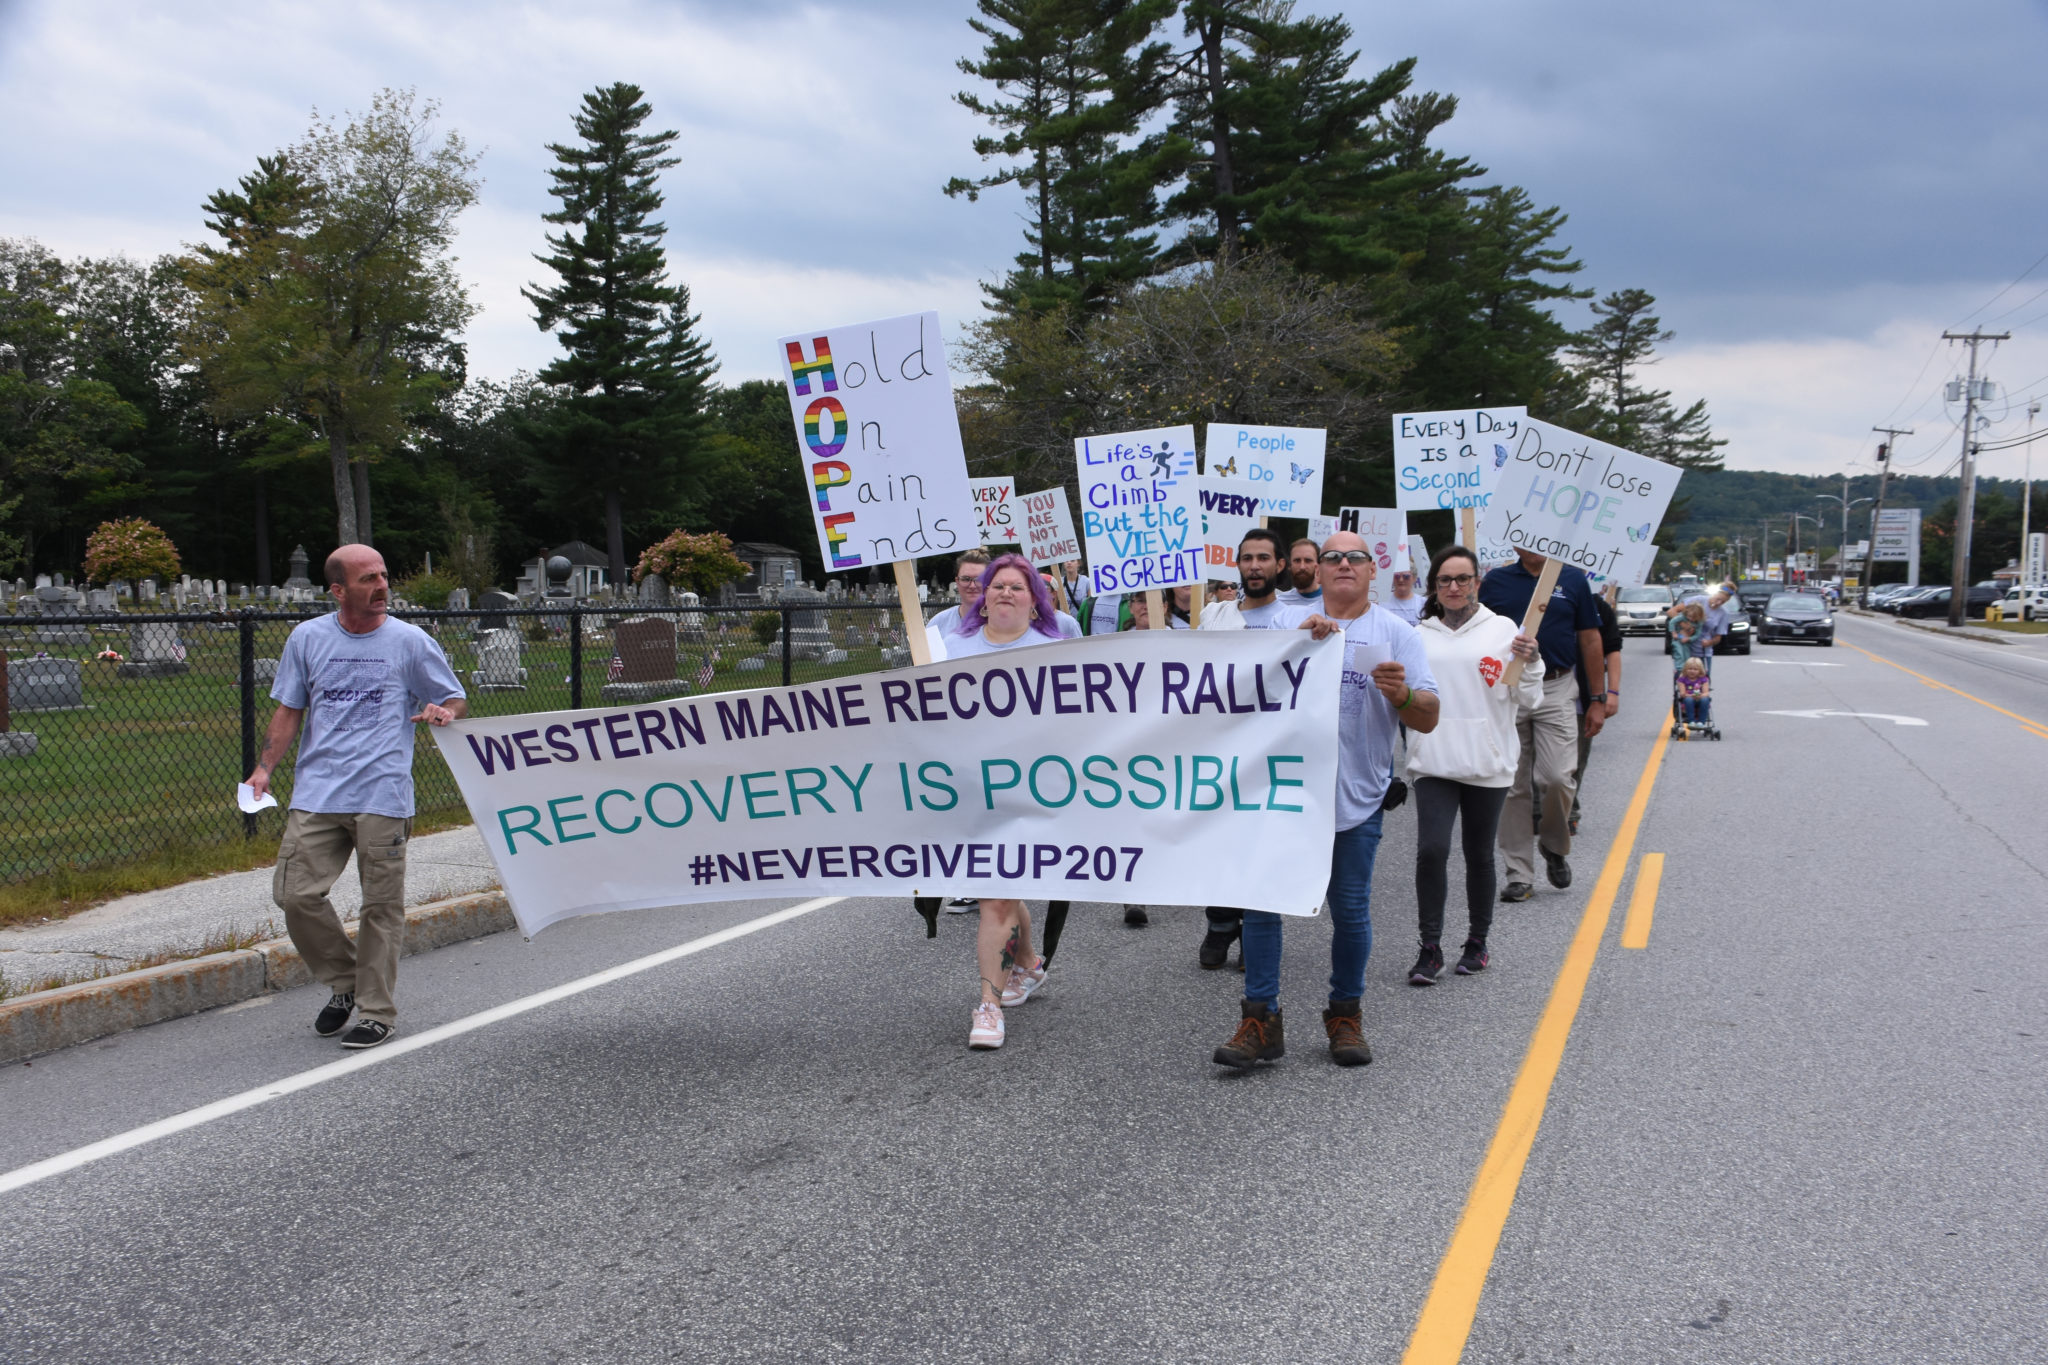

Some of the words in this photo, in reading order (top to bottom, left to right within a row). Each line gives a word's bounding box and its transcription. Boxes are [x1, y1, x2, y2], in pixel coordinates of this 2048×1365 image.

[786, 316, 933, 397] Hold
[804, 396, 886, 458] On
[1477, 411, 1518, 440] Day
[1084, 439, 1153, 465] Life's
[1238, 431, 1295, 453] People
[1460, 444, 1477, 458] a
[1121, 465, 1142, 482] a
[1249, 464, 1274, 481] Do
[1515, 427, 1594, 478] Don't
[1601, 455, 1652, 497] lose
[813, 461, 926, 511] Pain
[1399, 465, 1481, 491] Second
[972, 486, 1010, 503] VERY
[1022, 493, 1055, 513] YOU
[1089, 480, 1167, 508] Climb
[1525, 475, 1622, 533] HOPE
[1028, 512, 1054, 528] ARE
[1029, 525, 1058, 543] NOT
[1084, 511, 1134, 537] But
[1140, 503, 1189, 528] the
[823, 508, 957, 568] Ends
[1031, 539, 1078, 562] ALONE
[1108, 525, 1188, 558] VIEW
[1878, 537, 1902, 545] Jeep
[1121, 548, 1204, 588] GREAT
[323, 689, 384, 703] RECOVERY
[466, 704, 706, 776] WESTERN
[716, 684, 870, 742] MAINE
[881, 662, 1145, 724] RECOVERY
[1162, 657, 1311, 715] RALLY
[497, 763, 874, 855] RECOVERY
[899, 761, 959, 812] IS
[981, 754, 1304, 813] POSSIBLE
[688, 844, 1144, 885] #NEVERGIVEUP207
